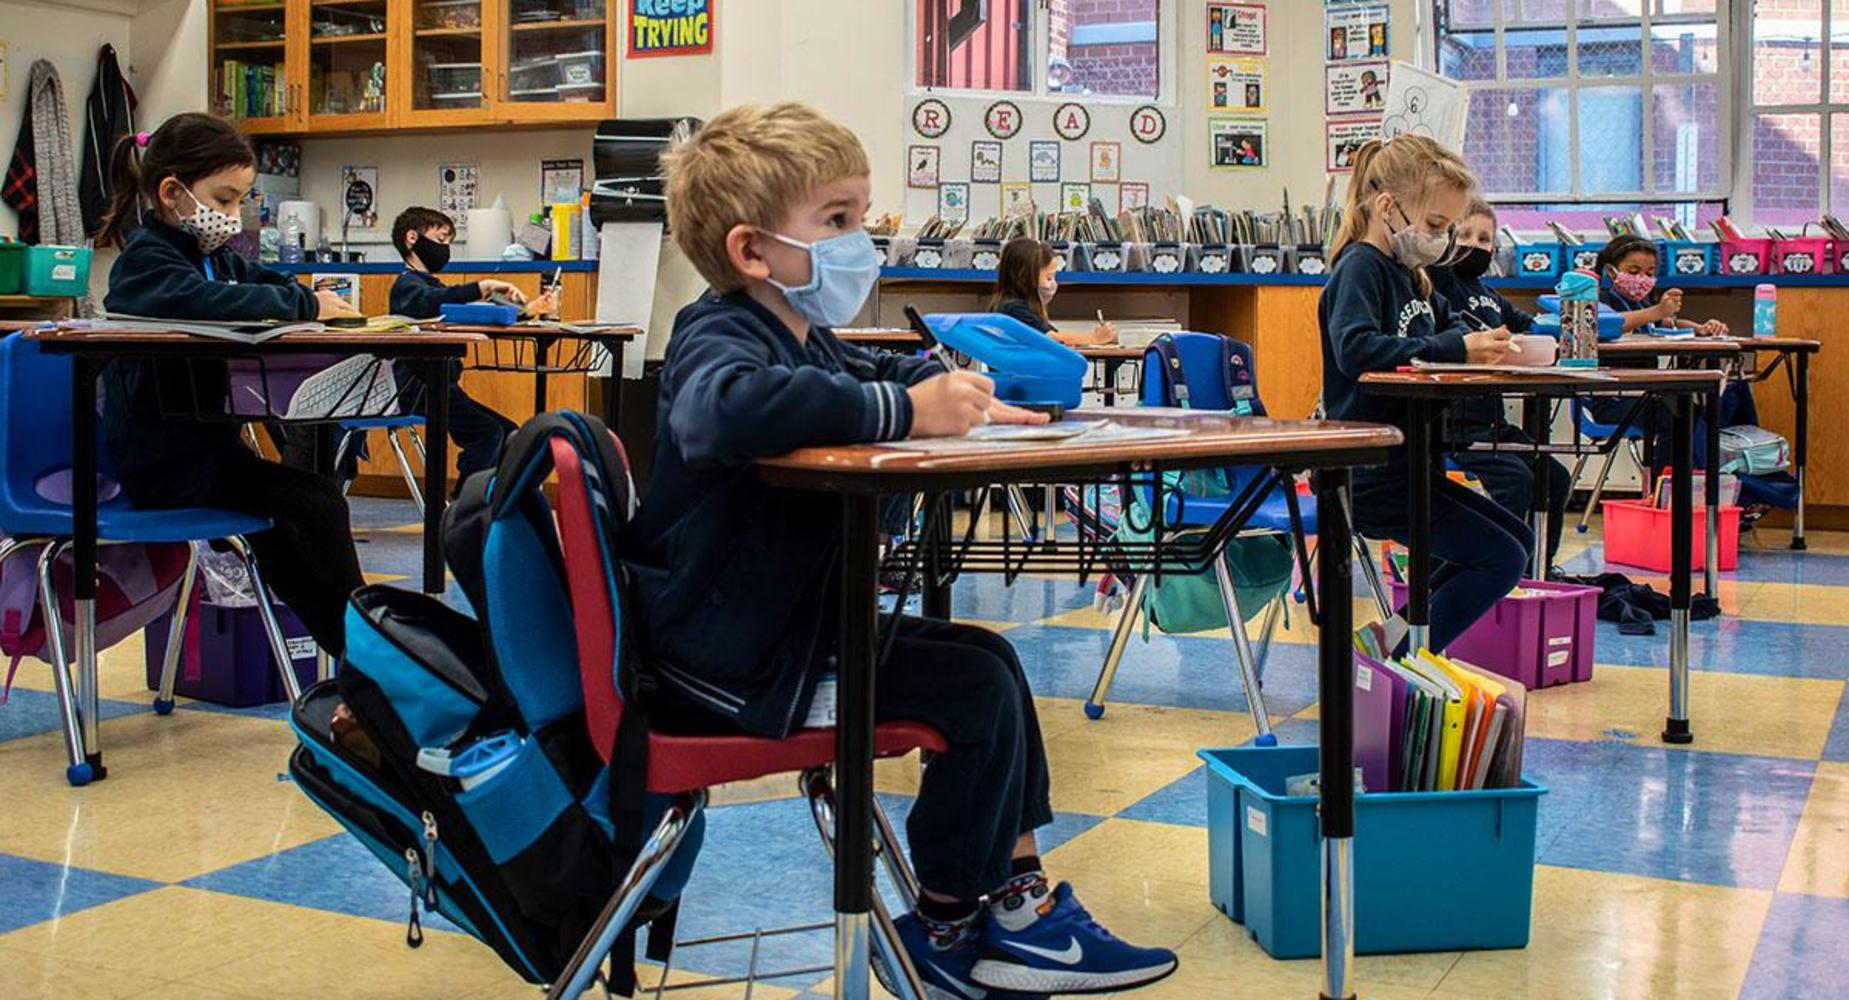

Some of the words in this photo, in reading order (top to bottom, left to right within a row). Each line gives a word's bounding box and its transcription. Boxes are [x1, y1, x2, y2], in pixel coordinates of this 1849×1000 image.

[634, 12, 708, 48] TRYING
[1410, 96, 1418, 114] 6
[923, 110, 940, 129] R
[996, 110, 1011, 131] E
[1064, 112, 1079, 129] A
[1140, 115, 1156, 134] D
